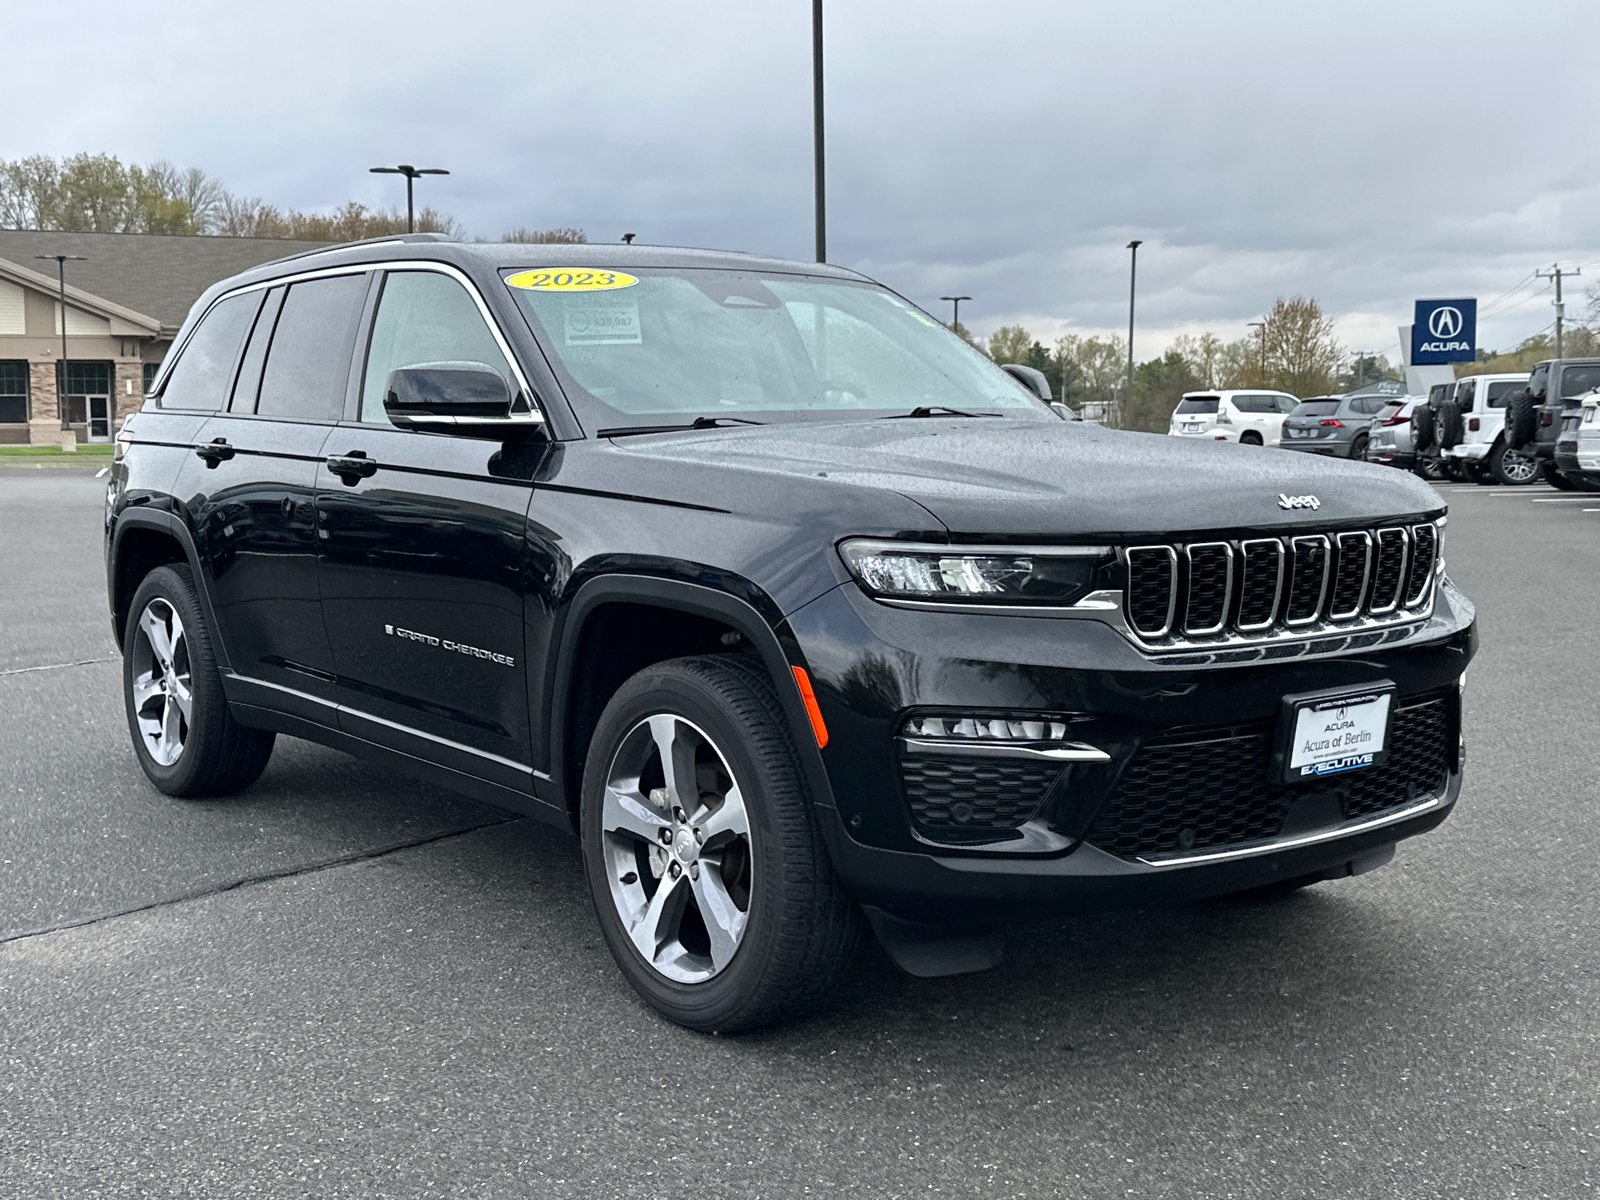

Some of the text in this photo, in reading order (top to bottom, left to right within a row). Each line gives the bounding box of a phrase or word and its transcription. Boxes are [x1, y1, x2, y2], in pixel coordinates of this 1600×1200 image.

[531, 273, 616, 287] 2023
[593, 317, 633, 328] $35,987
[1420, 342, 1470, 352] ACURA
[1278, 493, 1321, 511] Jeep
[396, 627, 515, 667] GRAND CHEROKEE
[1324, 721, 1355, 732] ACURA
[1303, 730, 1371, 753] Acura of Berlin
[1301, 754, 1374, 775] EXECUTIVE
